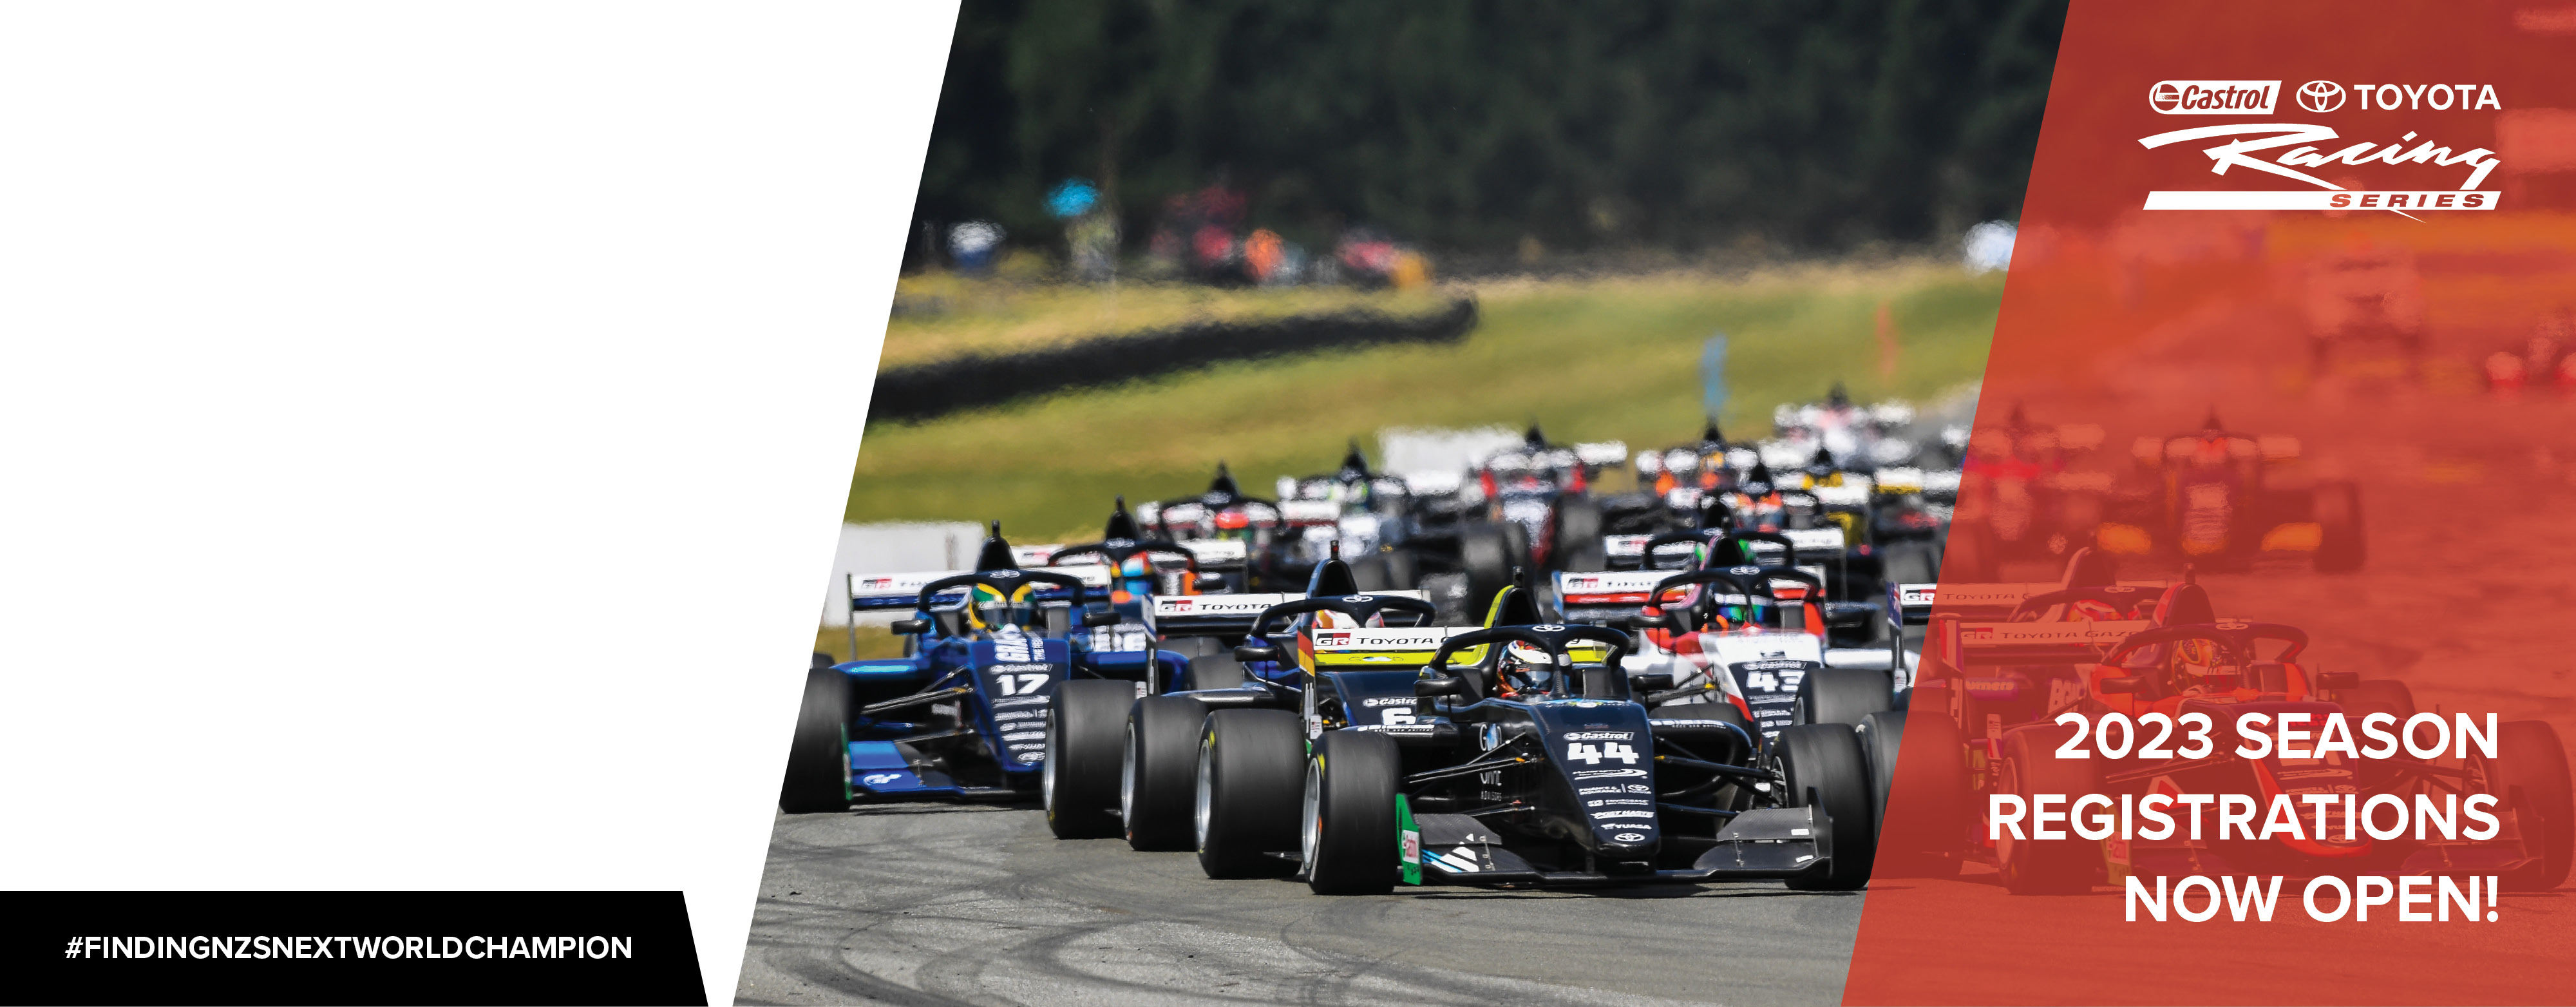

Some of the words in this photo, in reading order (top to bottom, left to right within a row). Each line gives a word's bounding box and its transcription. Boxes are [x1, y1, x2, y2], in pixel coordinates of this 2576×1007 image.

[1315, 633, 1351, 646] GR
[1356, 637, 1434, 645] TOYOTA
[995, 673, 1050, 696] 17
[1747, 669, 1806, 692] 43
[1381, 707, 1416, 725] 6
[1567, 742, 1640, 765] 44
